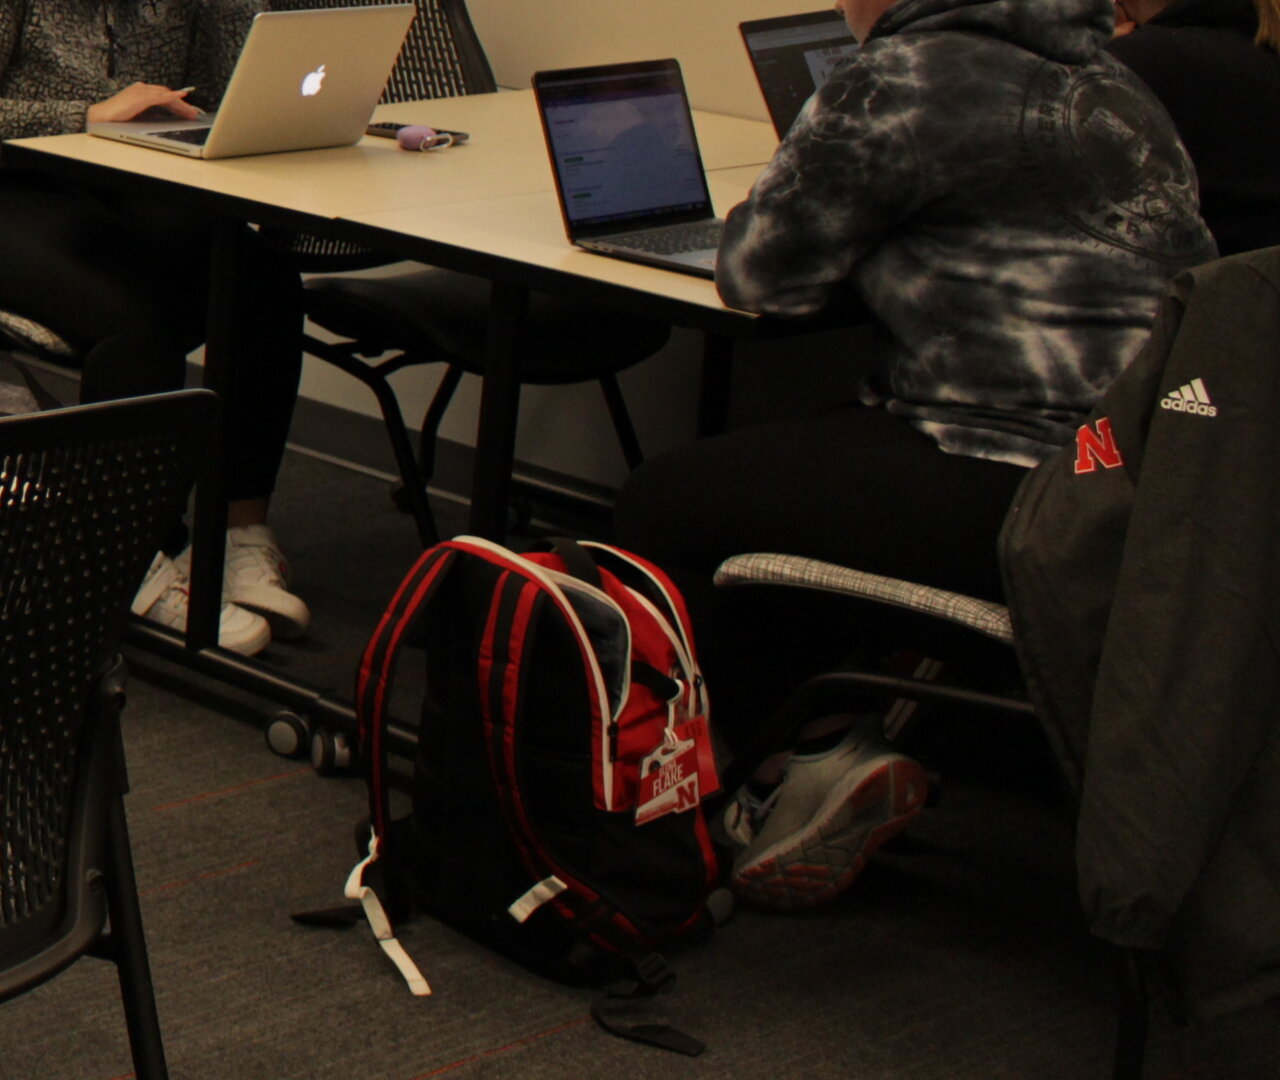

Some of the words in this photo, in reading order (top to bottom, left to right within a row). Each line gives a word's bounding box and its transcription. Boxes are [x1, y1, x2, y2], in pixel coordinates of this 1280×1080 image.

[1160, 396, 1217, 417] adidas
[1074, 416, 1123, 474] N
[652, 762, 684, 797] FLAKE
[674, 781, 697, 809] N
